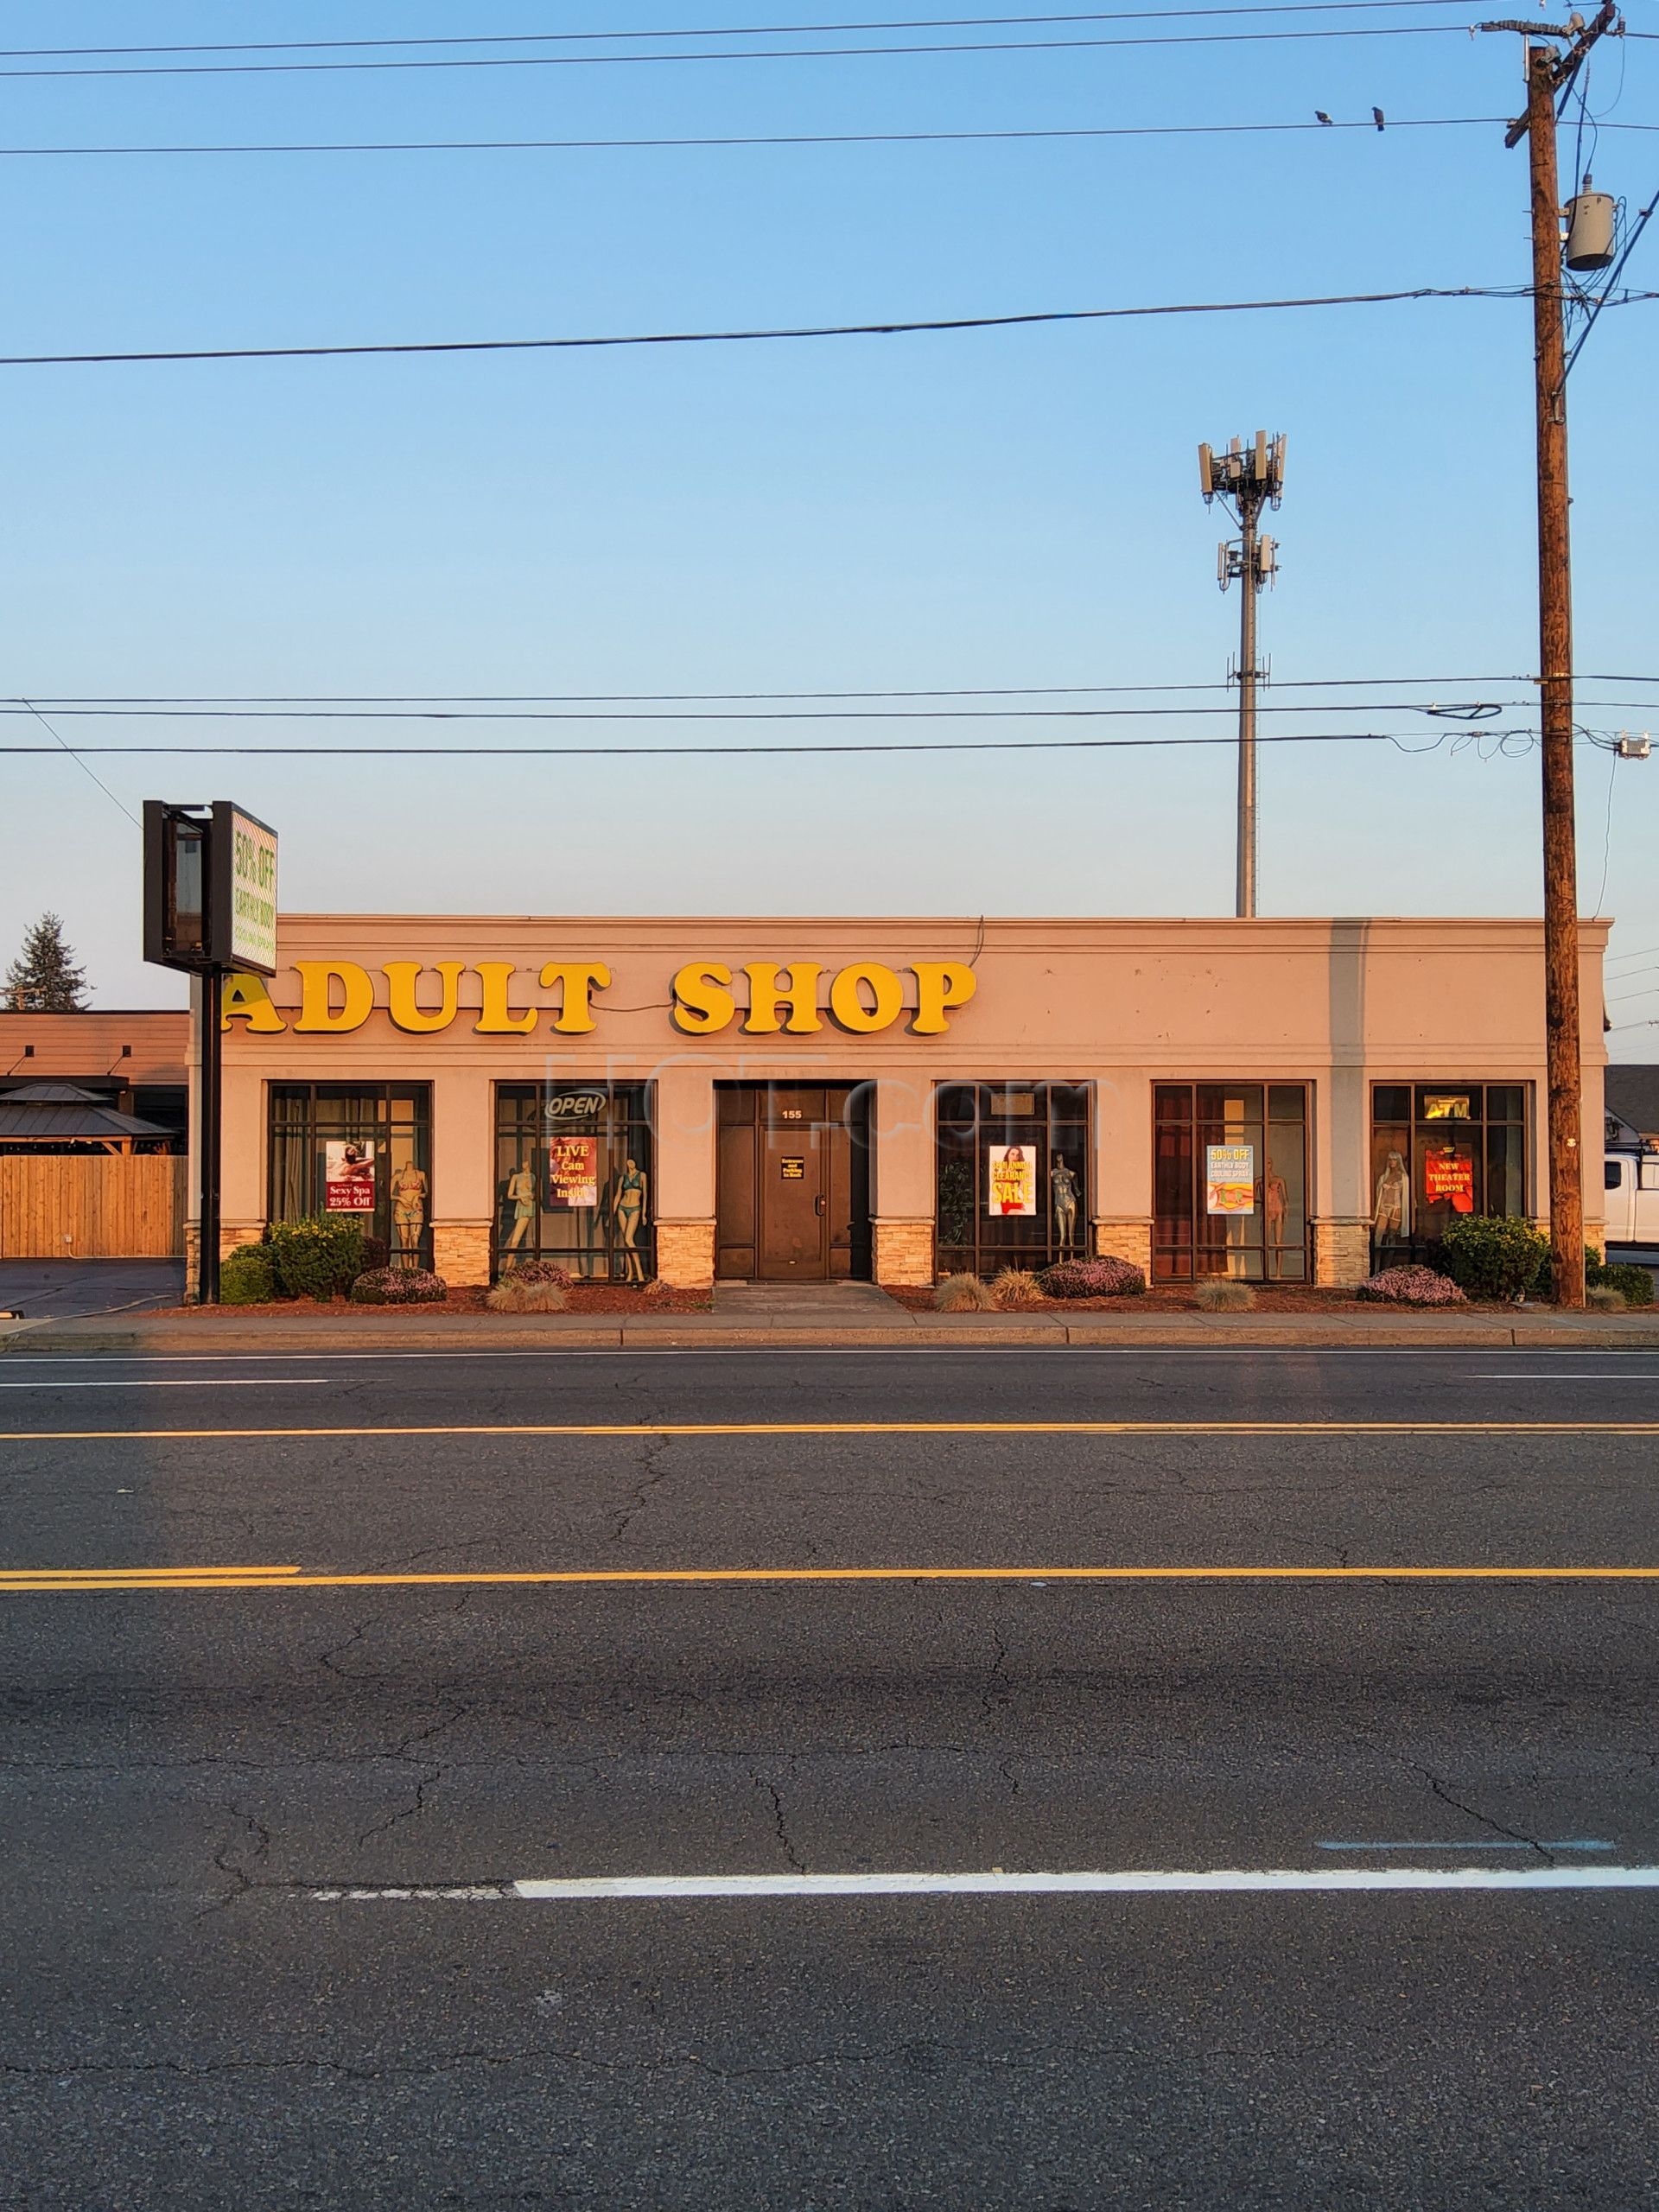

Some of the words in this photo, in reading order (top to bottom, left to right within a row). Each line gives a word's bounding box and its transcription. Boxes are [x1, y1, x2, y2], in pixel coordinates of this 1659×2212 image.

[220, 961, 610, 1033] ADULT
[671, 962, 977, 1034] SHOP
[548, 1096, 600, 1116] OPEN
[1427, 1103, 1467, 1118] ATM
[782, 1110, 803, 1119] 155
[556, 1145, 589, 1157] LIVE
[1211, 1148, 1231, 1160] 50%
[1233, 1148, 1249, 1160] OFF
[561, 1161, 585, 1171] Cam
[551, 1174, 596, 1185] Viewing
[992, 1171, 1033, 1181] CLEARANCE
[330, 1185, 352, 1197] Sexy
[353, 1185, 371, 1197] Spa
[556, 1188, 589, 1198] Inside
[992, 1182, 1033, 1204] SALE
[329, 1197, 352, 1206] 25%
[353, 1197, 372, 1206] Off
